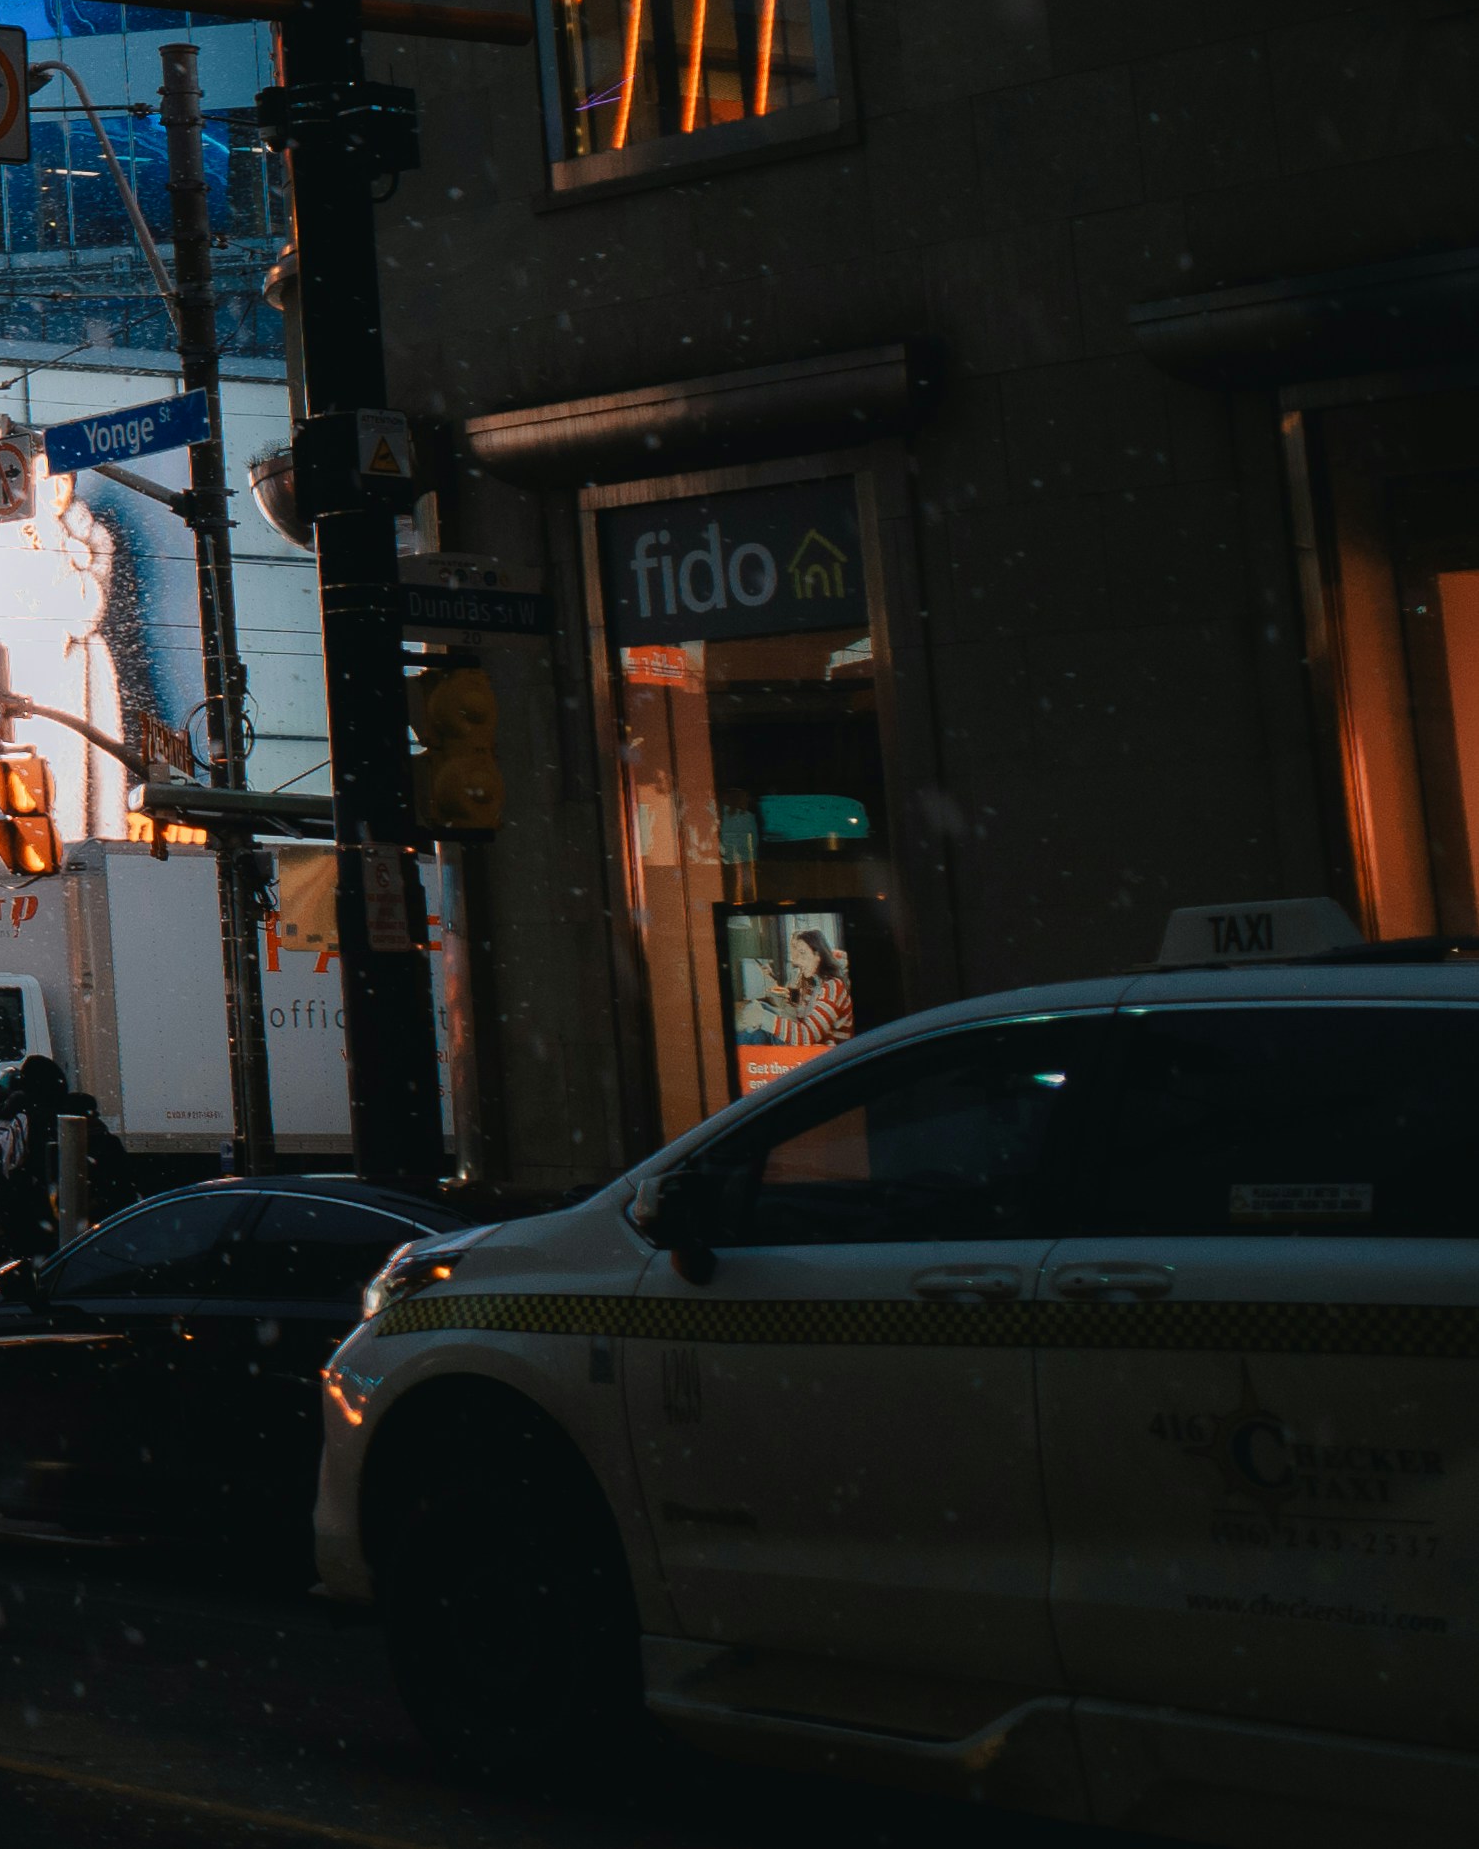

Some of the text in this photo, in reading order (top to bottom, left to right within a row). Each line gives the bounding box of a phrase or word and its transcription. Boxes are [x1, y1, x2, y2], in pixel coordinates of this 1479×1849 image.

[85, 405, 172, 456] Yonge St
[631, 522, 778, 619] fido
[409, 592, 536, 625] Dundas St W
[461, 630, 482, 645] 20
[1208, 913, 1274, 953] TAXI
[747, 1062, 768, 1075] Get
[1149, 1413, 1205, 1444] 416
[1233, 1420, 1446, 1488] CHECKER
[1298, 1474, 1390, 1504] TAXI
[1186, 1590, 1449, 1635] www.checkerstaxi.com
